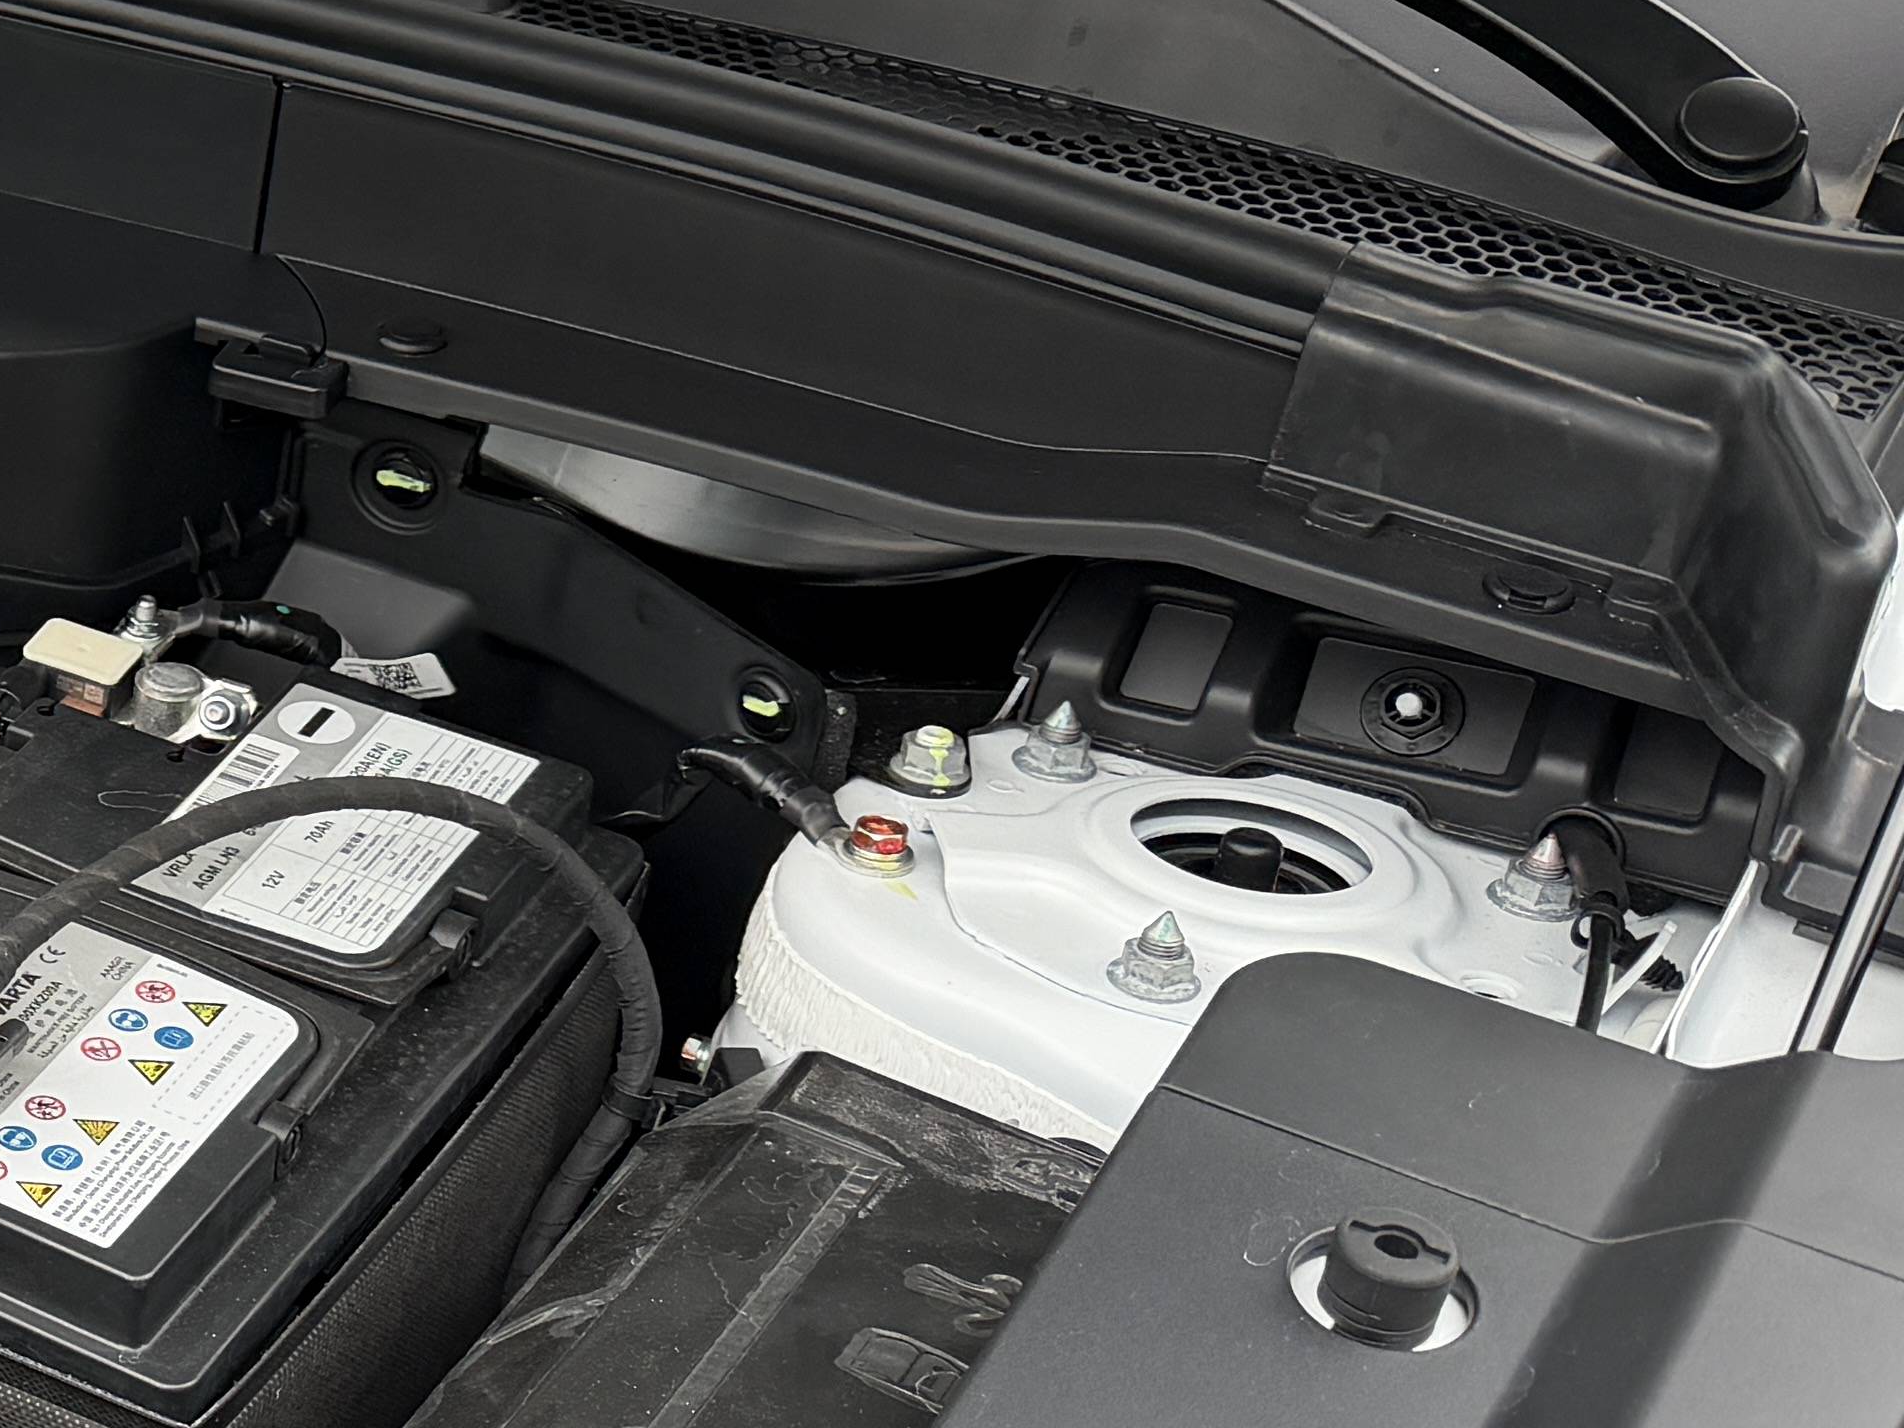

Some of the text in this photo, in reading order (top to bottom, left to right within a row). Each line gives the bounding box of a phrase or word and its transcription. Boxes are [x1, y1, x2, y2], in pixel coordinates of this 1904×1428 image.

[303, 818, 335, 844] 70Ah
[190, 864, 223, 890] AGM
[212, 845, 241, 866] LN3
[260, 869, 287, 890] 12V
